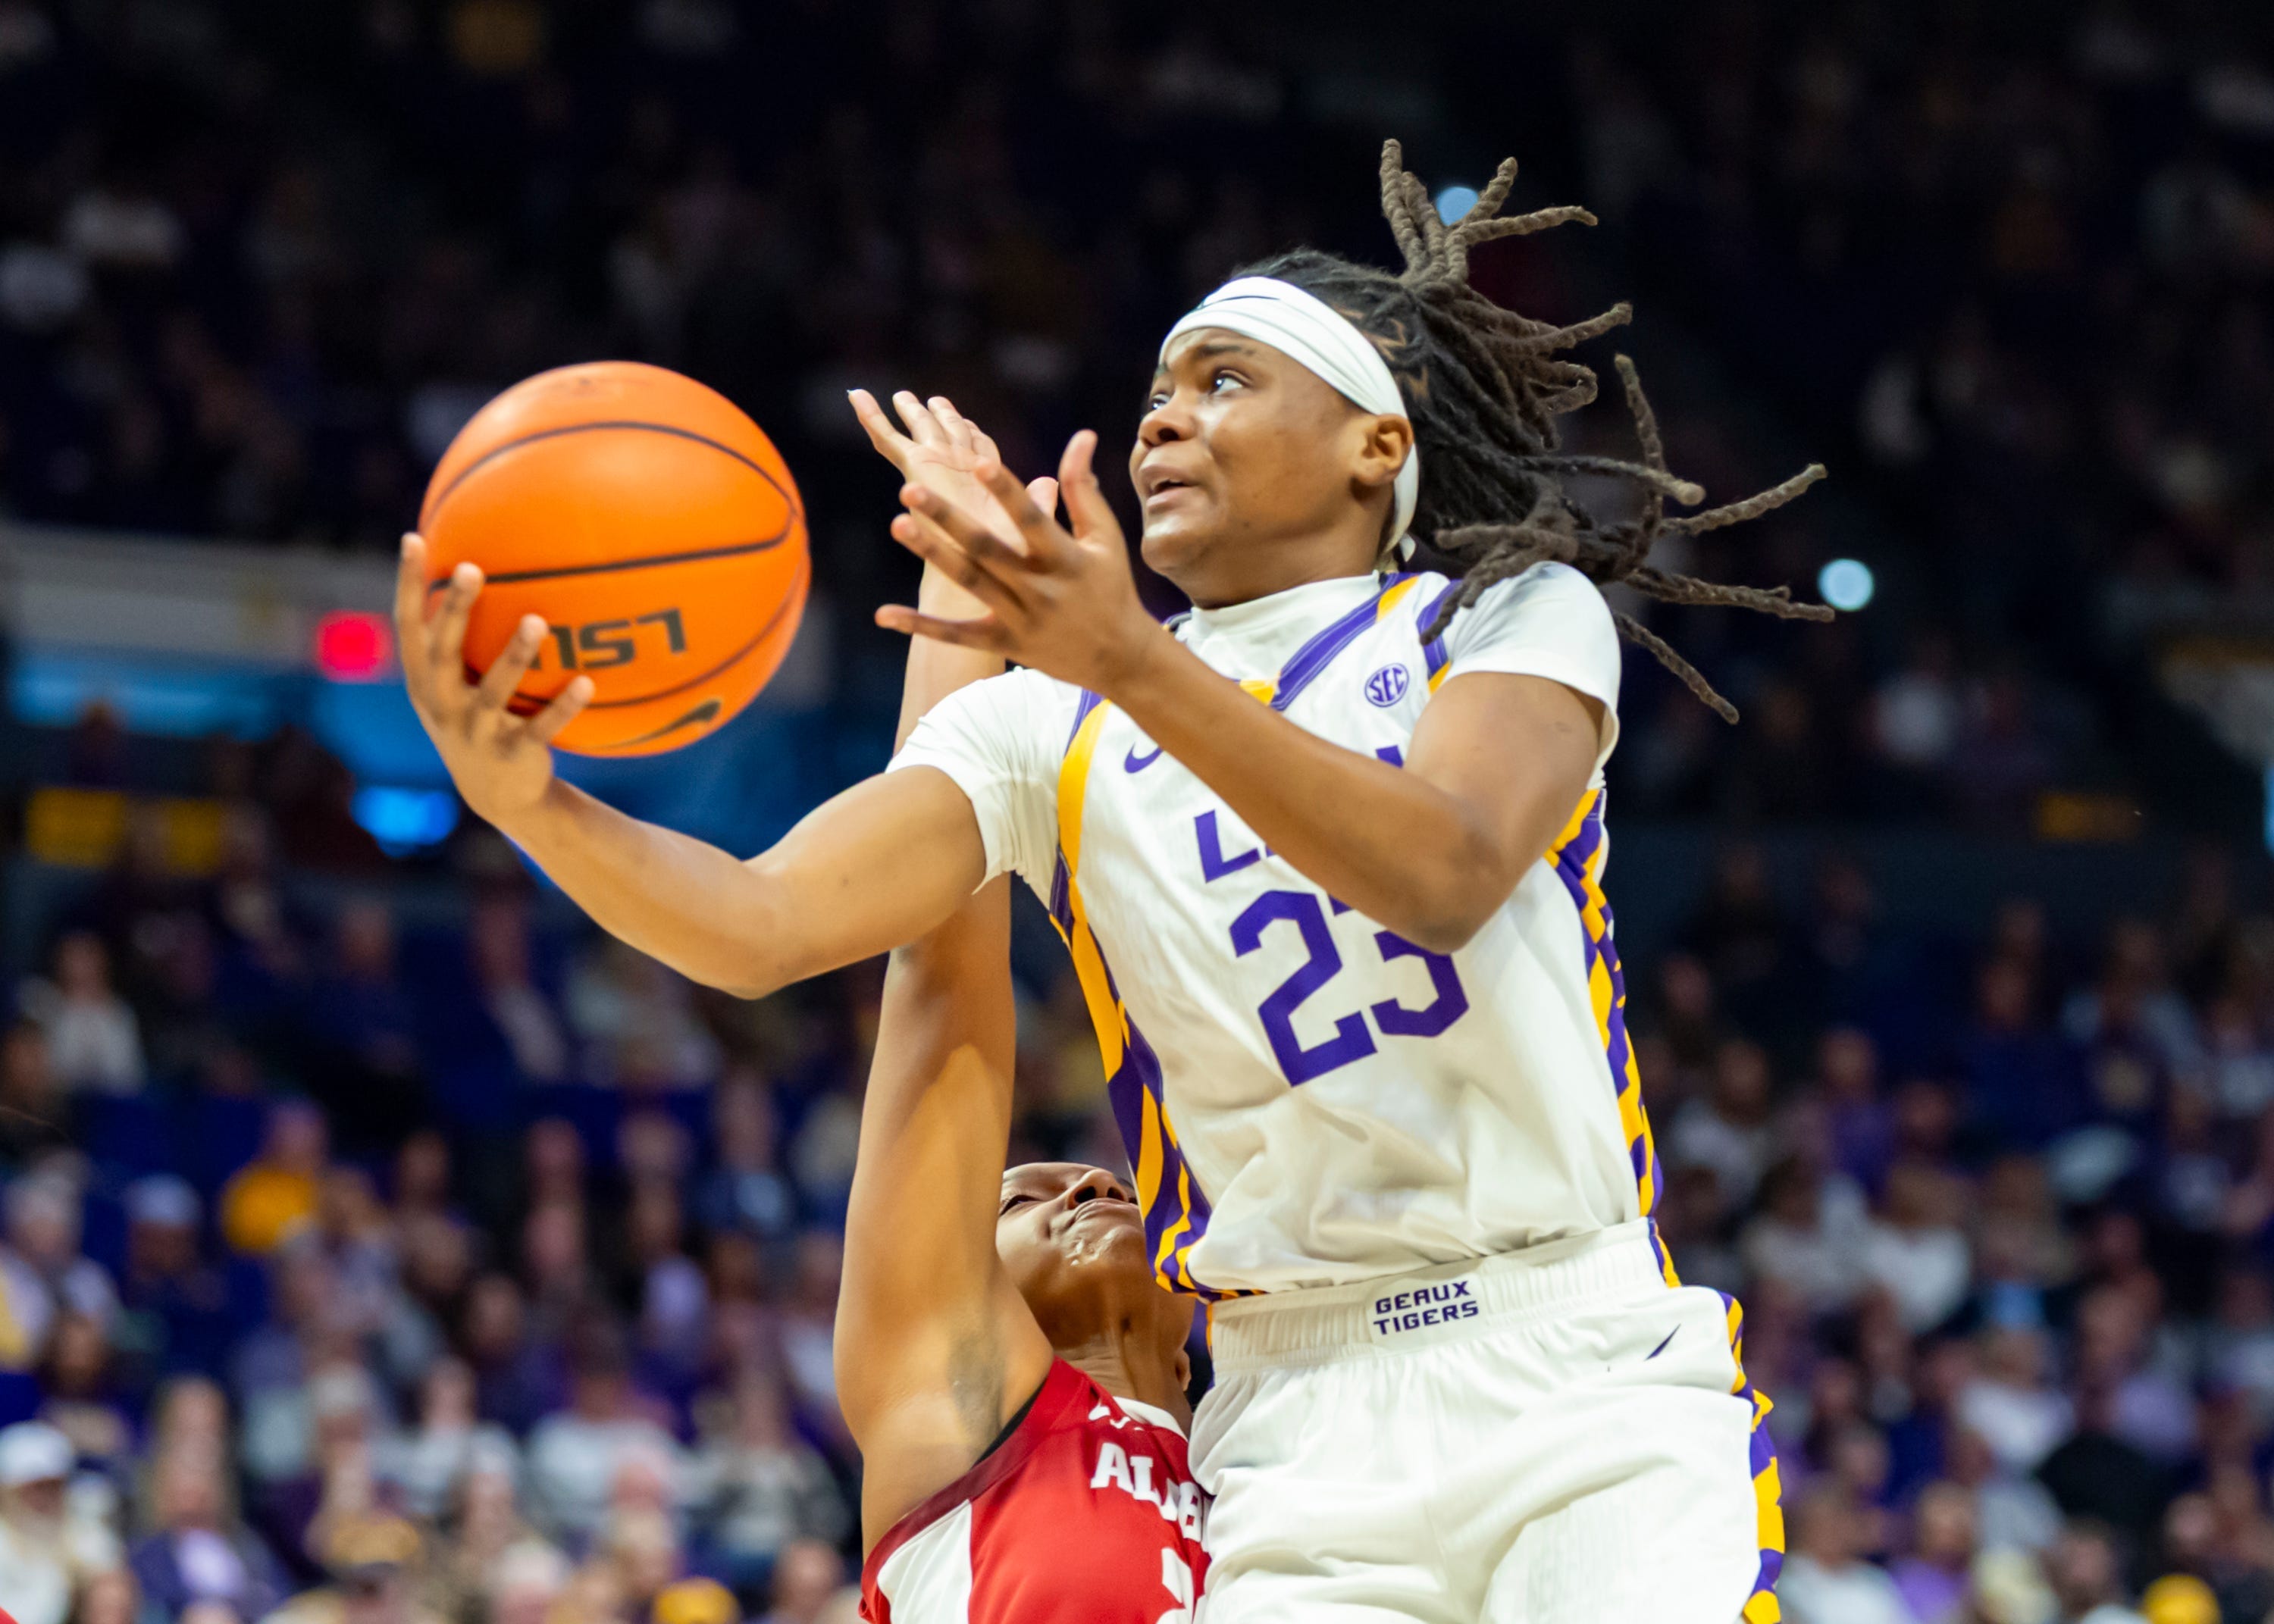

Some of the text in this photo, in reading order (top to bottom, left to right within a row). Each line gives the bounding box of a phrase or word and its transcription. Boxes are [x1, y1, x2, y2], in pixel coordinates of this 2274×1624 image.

[1368, 667, 1405, 703] SEC
[1229, 890, 1470, 1087] 23
[1374, 1279, 1472, 1315] GEAUX
[1373, 1300, 1480, 1336] TIGERS
